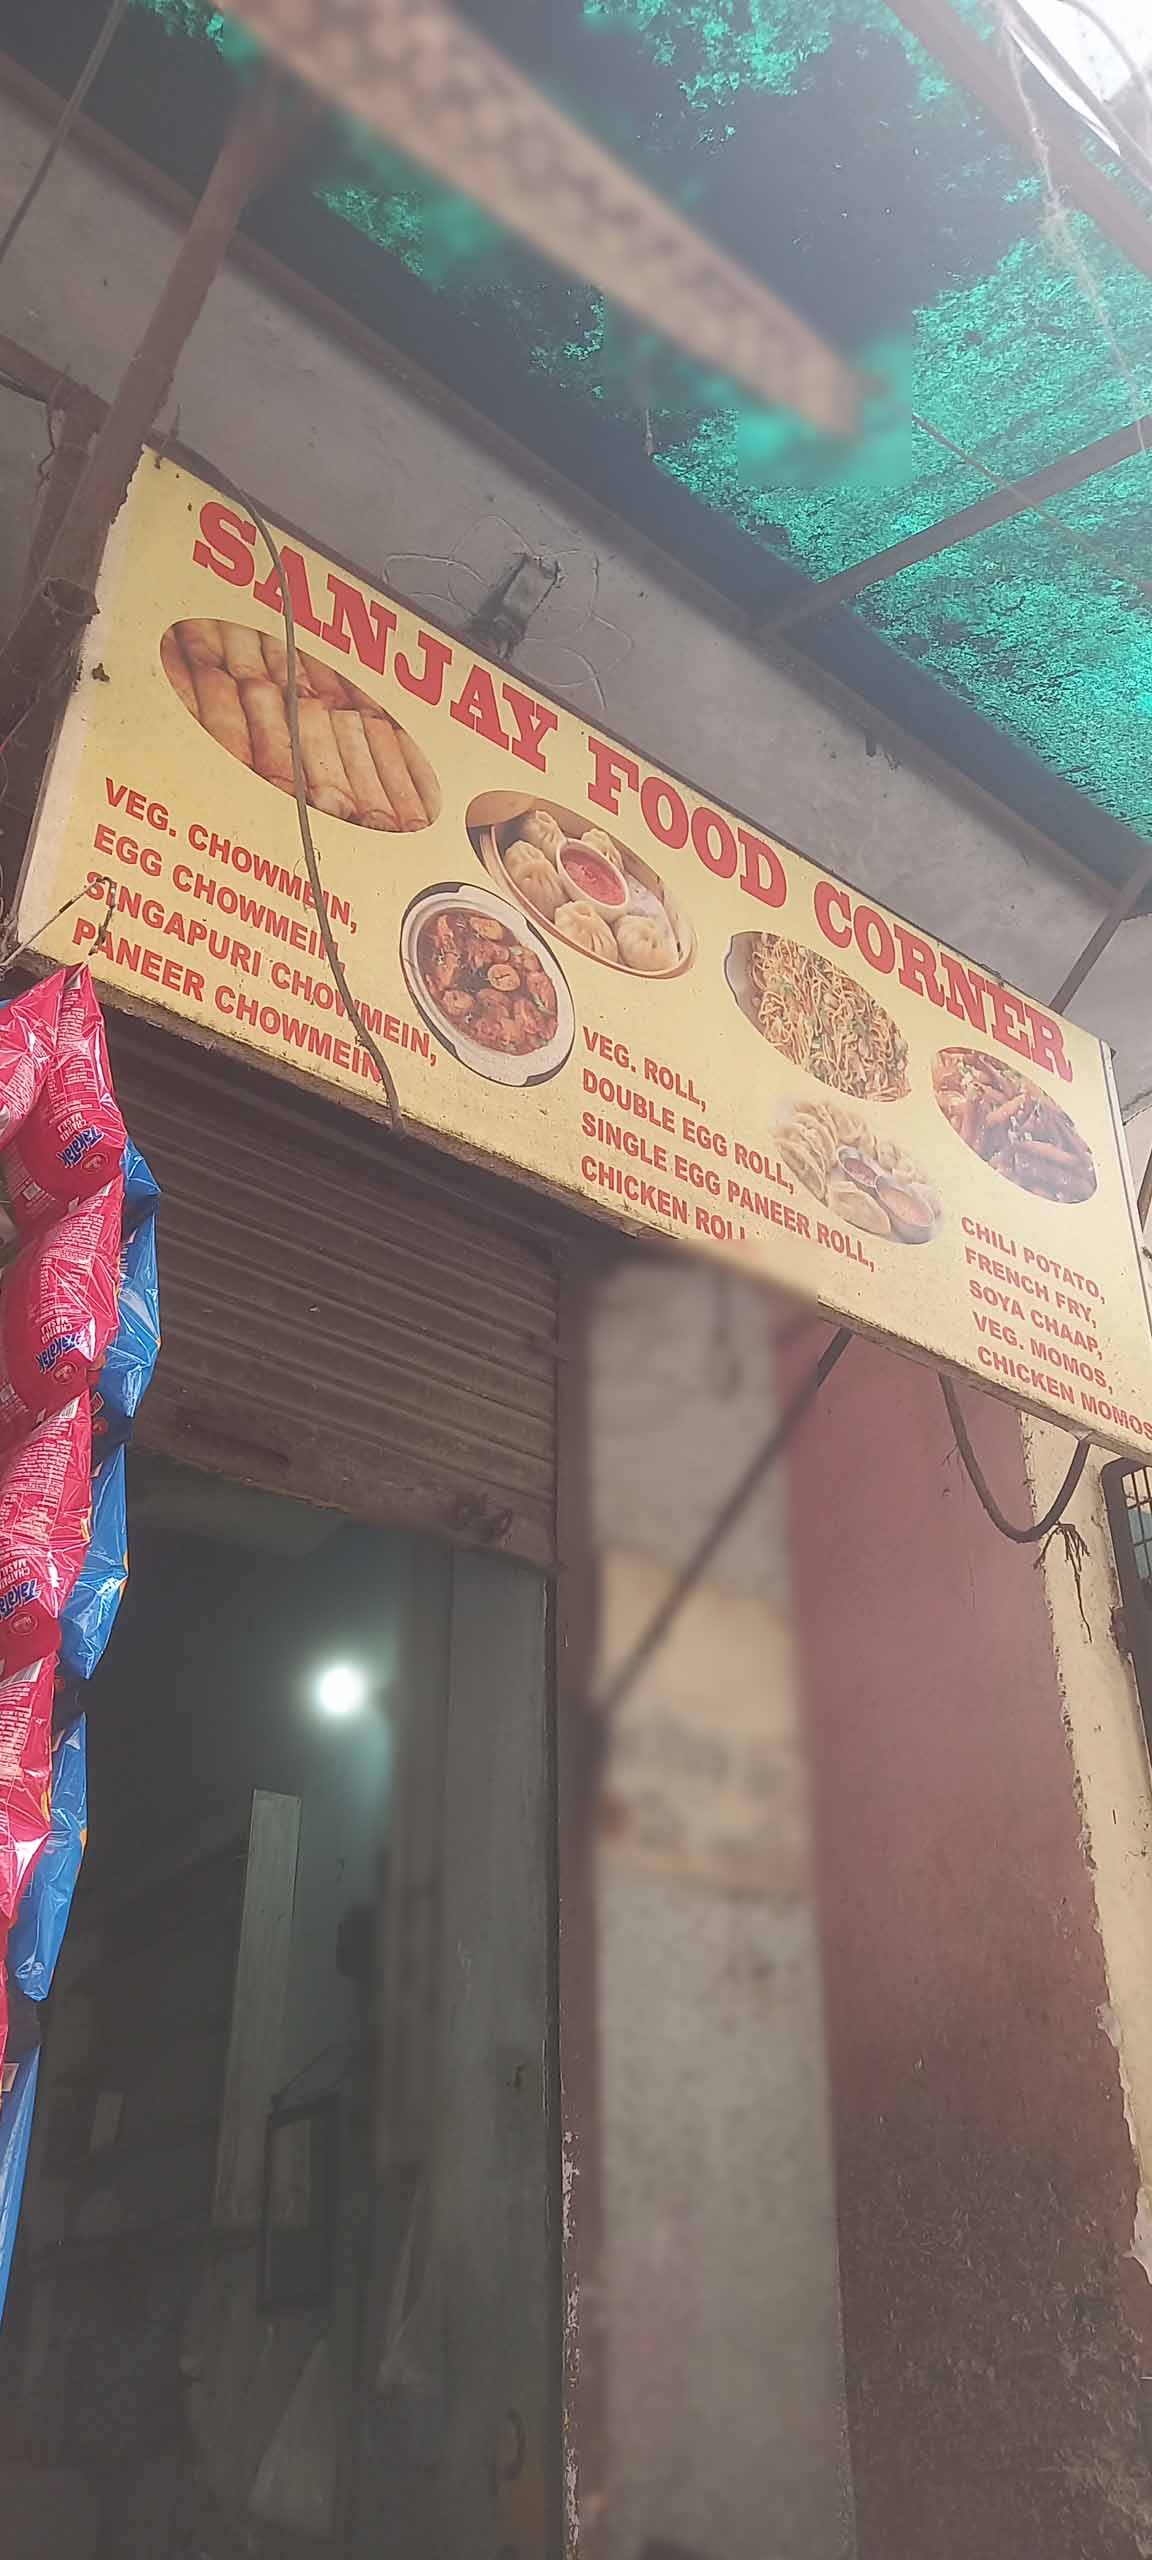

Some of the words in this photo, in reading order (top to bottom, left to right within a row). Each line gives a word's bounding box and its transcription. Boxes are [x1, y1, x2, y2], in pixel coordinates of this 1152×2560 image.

[193, 501, 558, 772] SANJAY
[588, 736, 786, 907] FOOD
[813, 881, 1073, 1082] CORNER
[94, 824, 162, 877] EGG
[105, 777, 176, 837] VEG.
[188, 824, 358, 934] CHOWMEIN,
[72, 918, 205, 1002] PANEER
[85, 871, 261, 977] SINGAPURI
[583, 1026, 636, 1072] VEG.
[644, 1057, 706, 1112] ROLL,
[583, 1068, 675, 1133] DOUBLE
[682, 1117, 727, 1157] EGG
[734, 1142, 794, 1194] ROLL,
[581, 1155, 688, 1224] CHICKEN
[582, 1112, 667, 1171] SINGLE
[674, 1154, 720, 1195] EGG
[727, 1179, 810, 1239] PANEER
[816, 1221, 875, 1272] ROLL,
[961, 1217, 1017, 1257] CHILI
[1024, 1247, 1105, 1304] POTATO,
[965, 1246, 1049, 1302] FRENCH
[1055, 1291, 1097, 1328] FRY,
[969, 1279, 1025, 1320] SOYA
[1030, 1309, 1103, 1361] CHAAP,
[973, 1311, 1024, 1349] VEG.
[1030, 1338, 1113, 1395] MOMOS,
[978, 1346, 1075, 1404] CHICKEN
